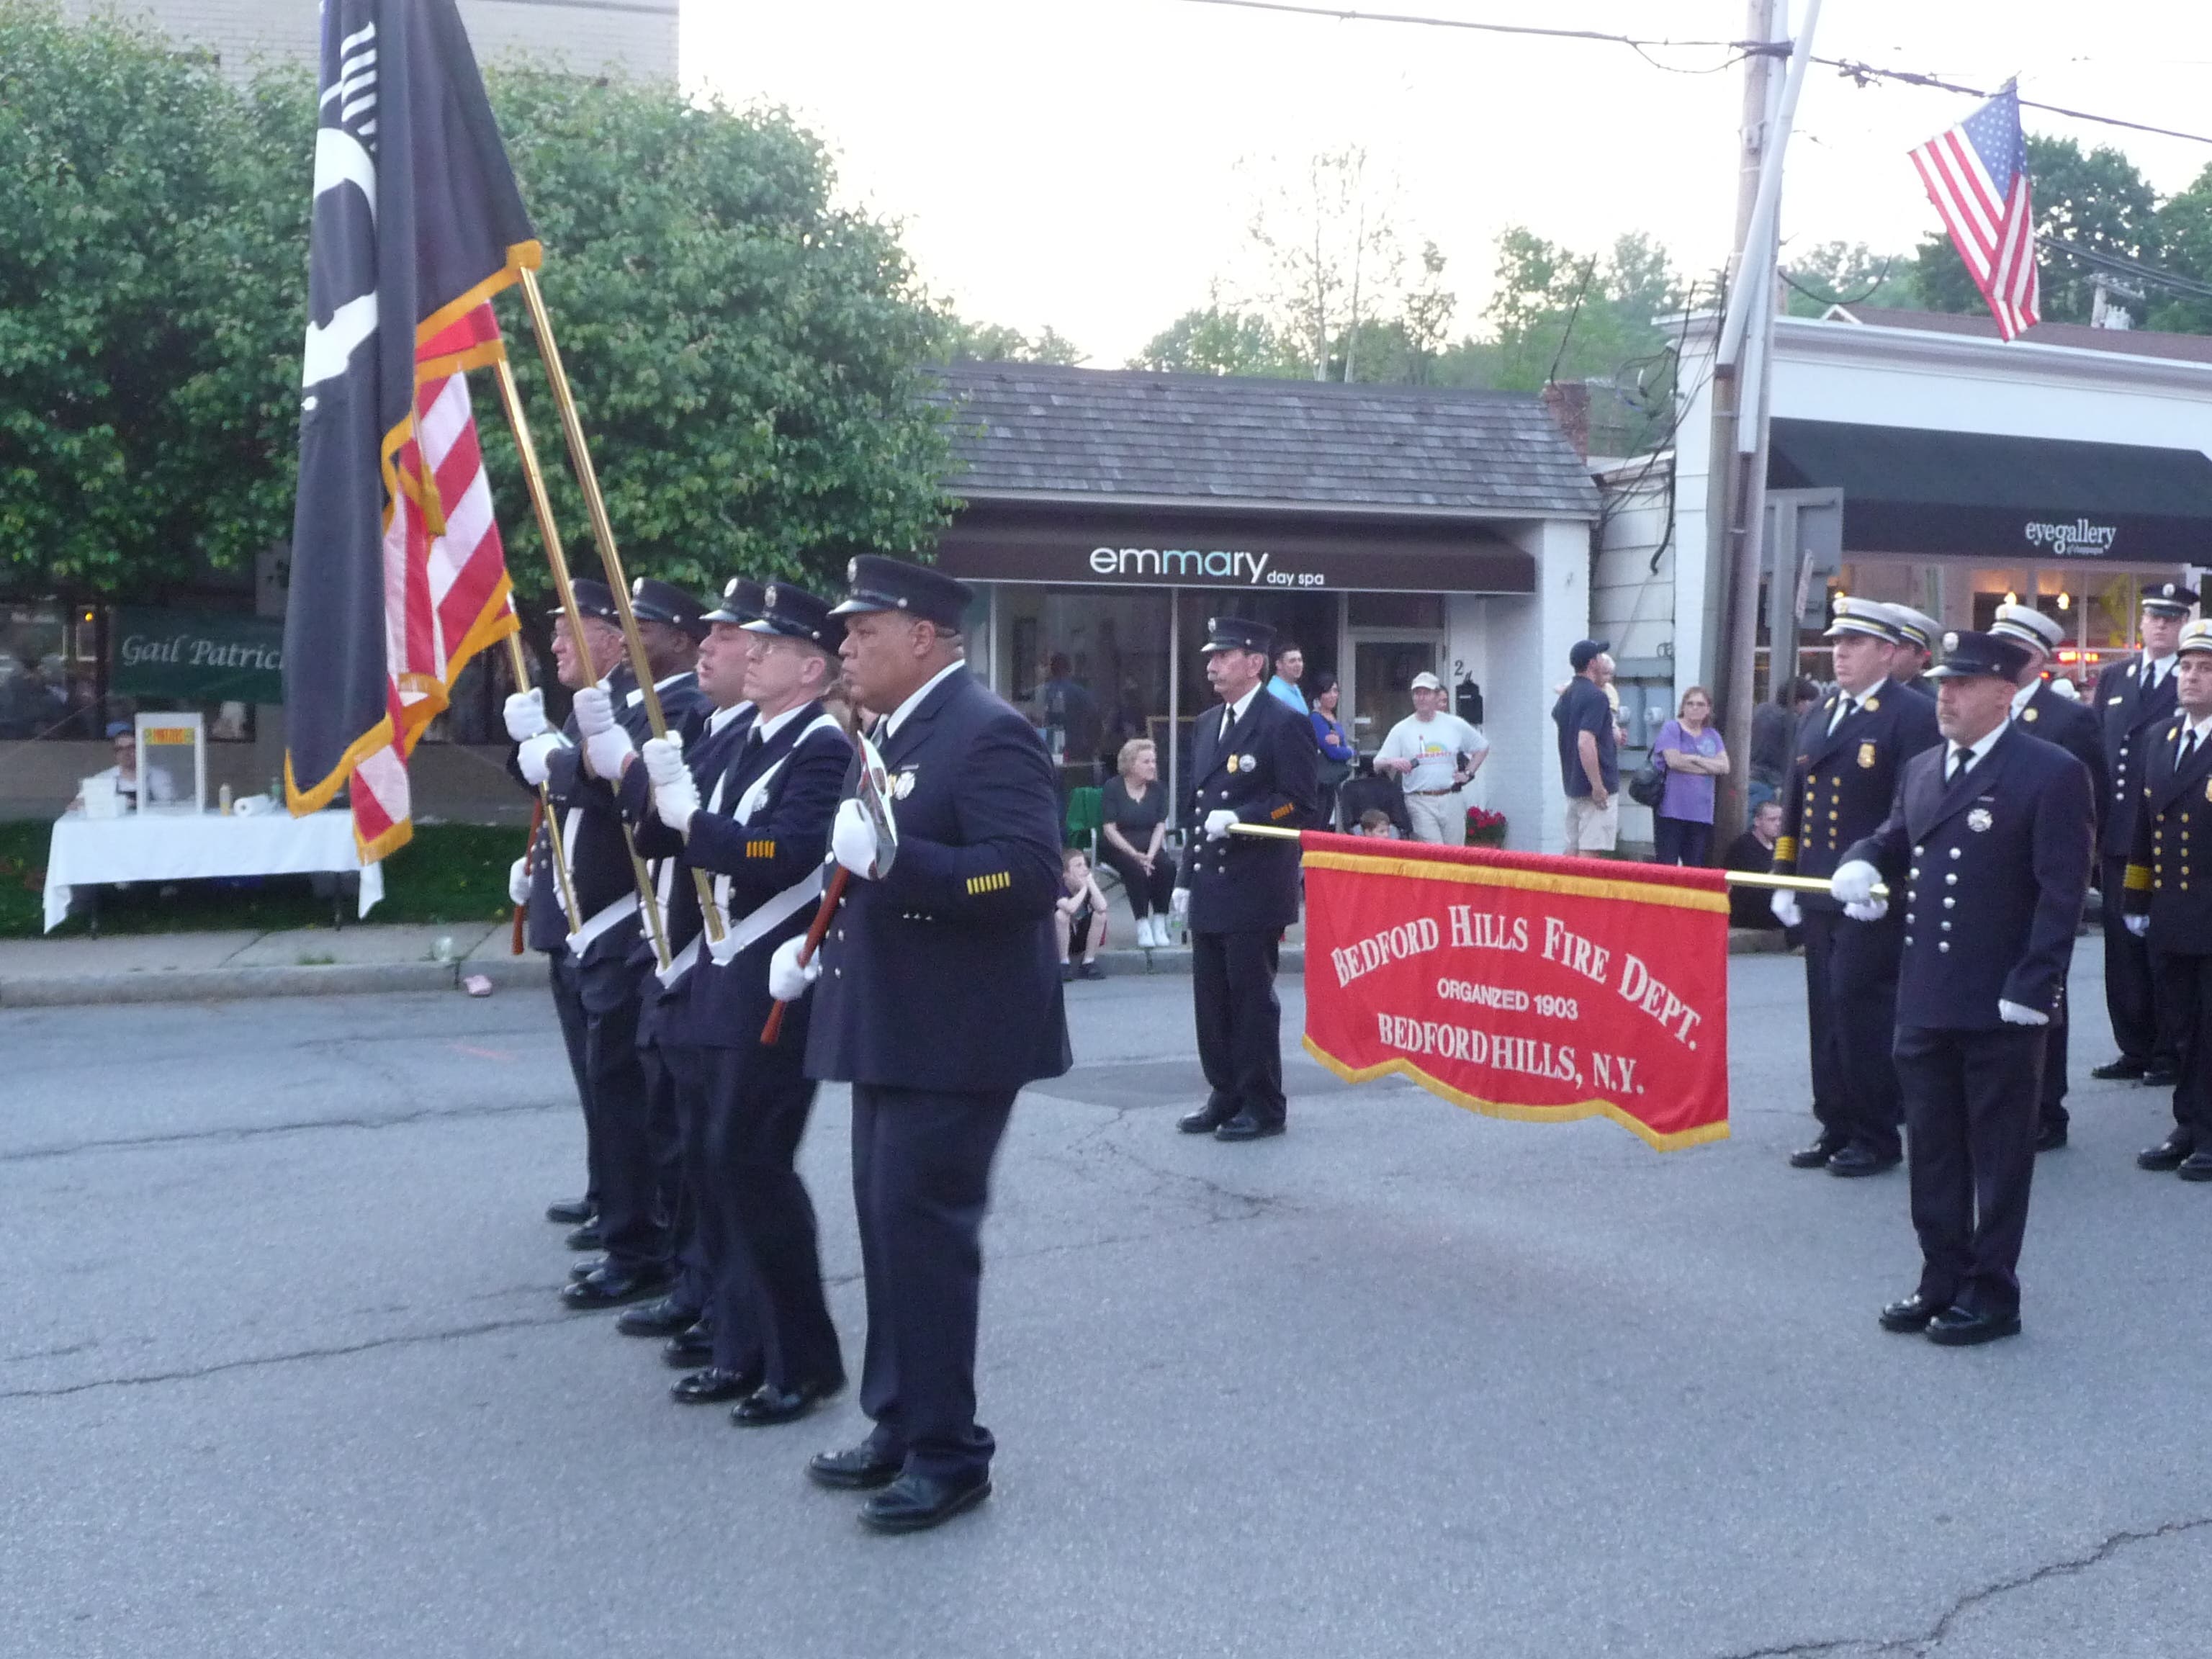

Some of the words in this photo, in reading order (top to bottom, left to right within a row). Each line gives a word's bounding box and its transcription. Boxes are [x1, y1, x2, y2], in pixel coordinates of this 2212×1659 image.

[2026, 518, 2116, 554] eyegallery
[1089, 548, 1269, 584] emmary
[1267, 571, 1294, 585] day
[1298, 573, 1324, 585] spa
[122, 634, 190, 666] Gail
[1534, 994, 1578, 1020] 1903
[1592, 1052, 1644, 1094] N.Y.
